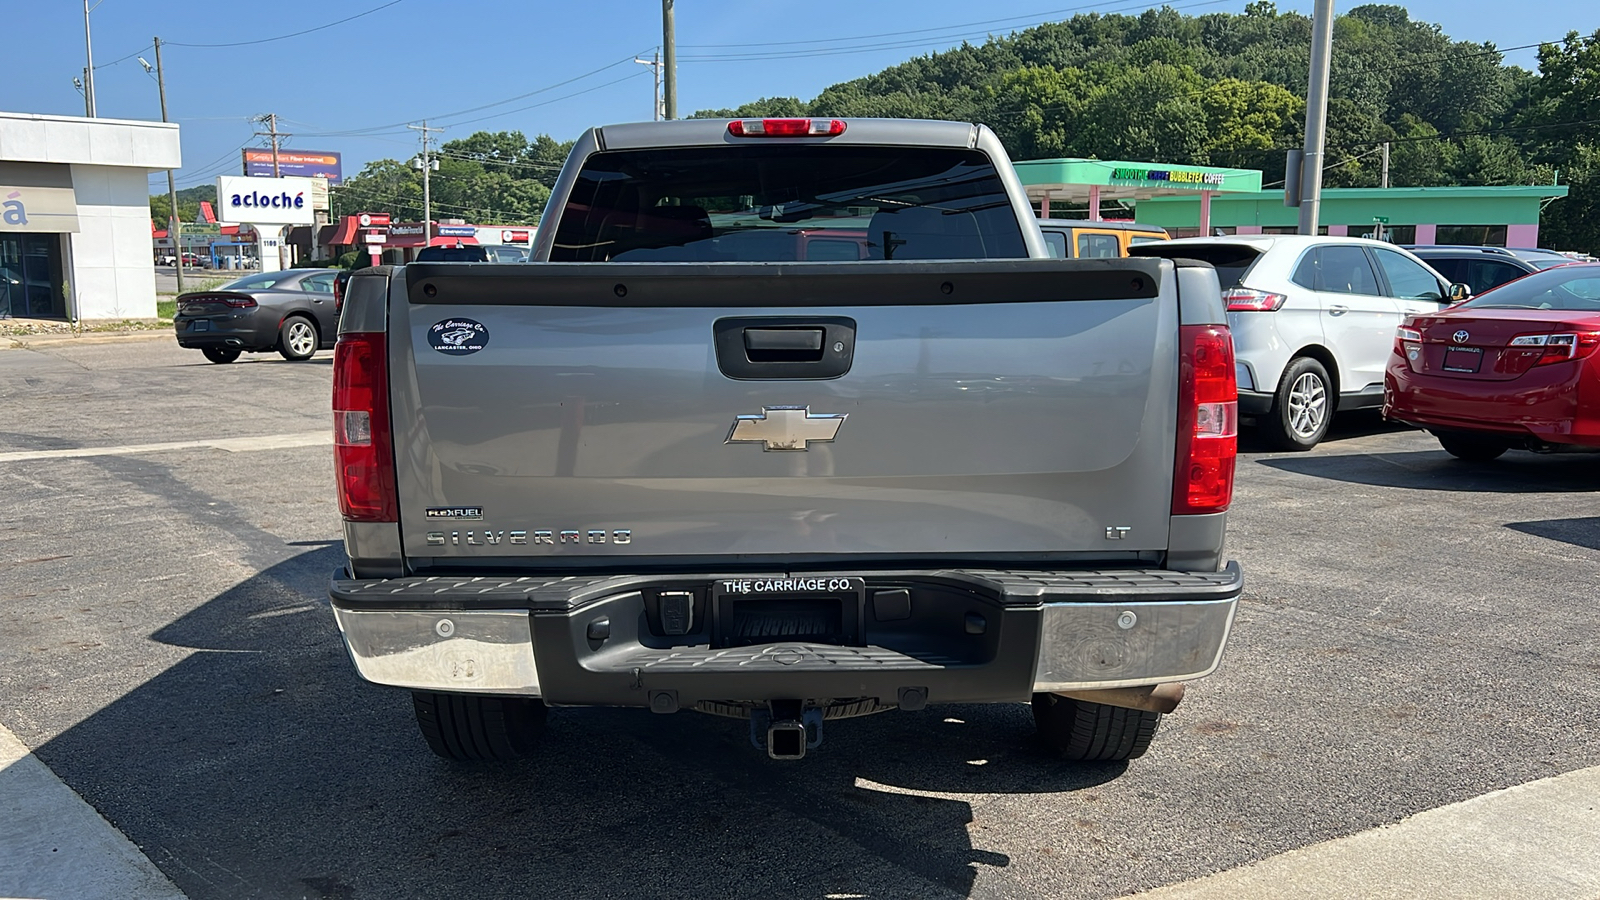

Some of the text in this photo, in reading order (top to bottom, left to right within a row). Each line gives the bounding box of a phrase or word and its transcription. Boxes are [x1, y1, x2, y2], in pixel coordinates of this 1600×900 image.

[1204, 173, 1225, 184] COFFEE
[232, 191, 303, 209] acloché
[445, 320, 473, 330] Carriage
[426, 530, 632, 546] SILVERADO
[1106, 526, 1132, 539] LT
[723, 578, 853, 593] THE CARRIAGE CO.
